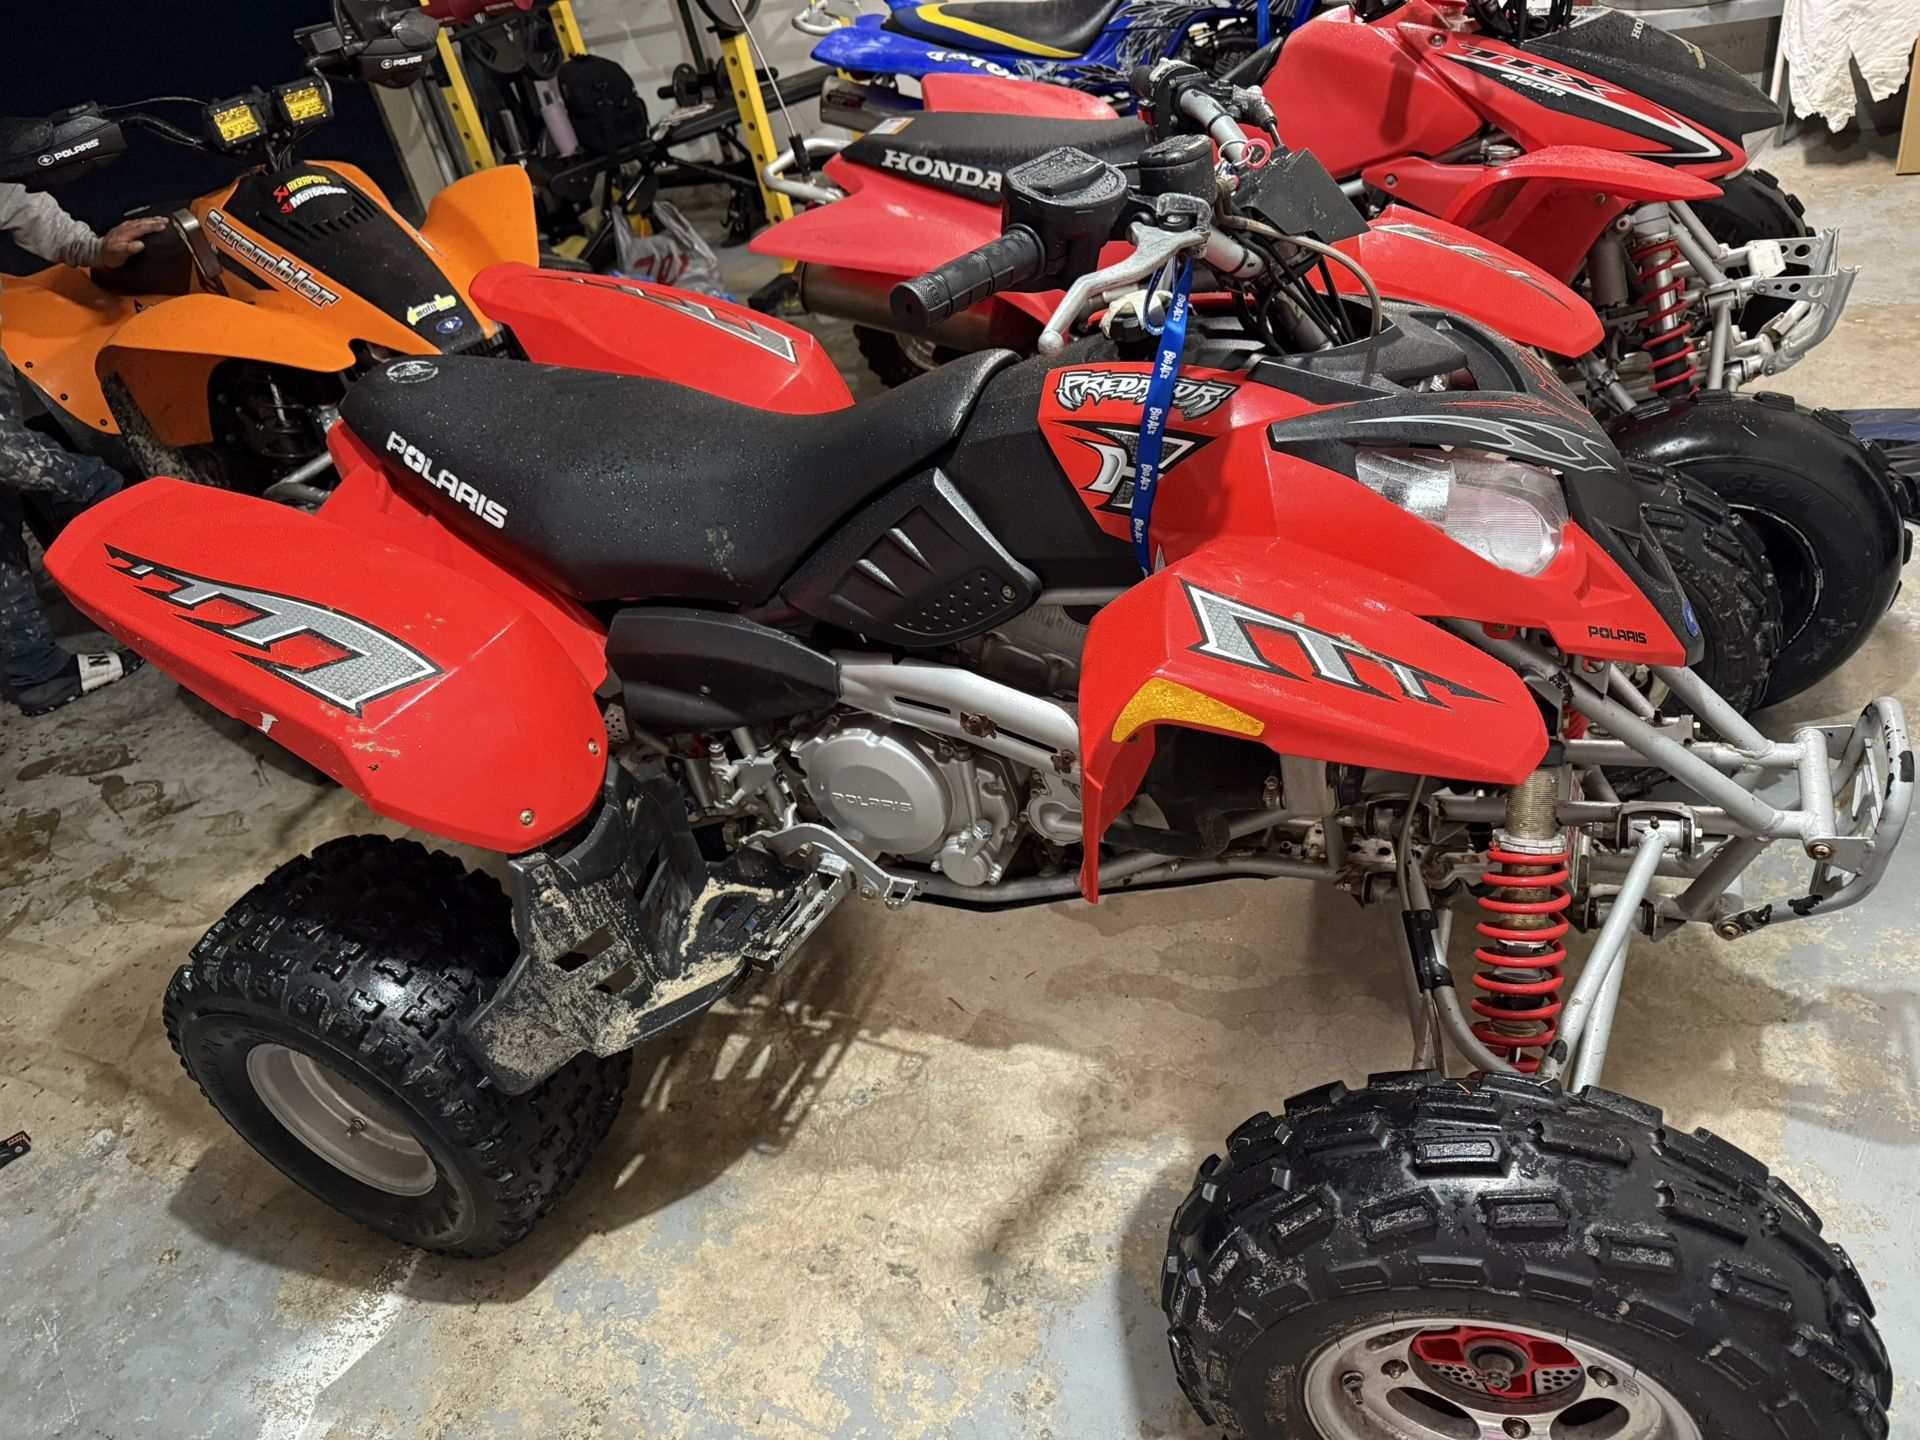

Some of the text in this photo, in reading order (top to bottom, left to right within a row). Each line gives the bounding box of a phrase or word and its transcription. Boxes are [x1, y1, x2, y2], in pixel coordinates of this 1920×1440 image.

[393, 54, 423, 67] POLARIS
[1458, 43, 1627, 98] TRX
[1501, 73, 1566, 97] 450R
[53, 138, 100, 161] POLARIS
[881, 149, 1003, 192] HONDA
[205, 209, 340, 308] Scrambler
[1055, 370, 1240, 421] PREDAOR
[386, 431, 508, 529] POLARIS
[1587, 625, 1648, 645] POLARIS
[831, 791, 913, 813] POLARIS
